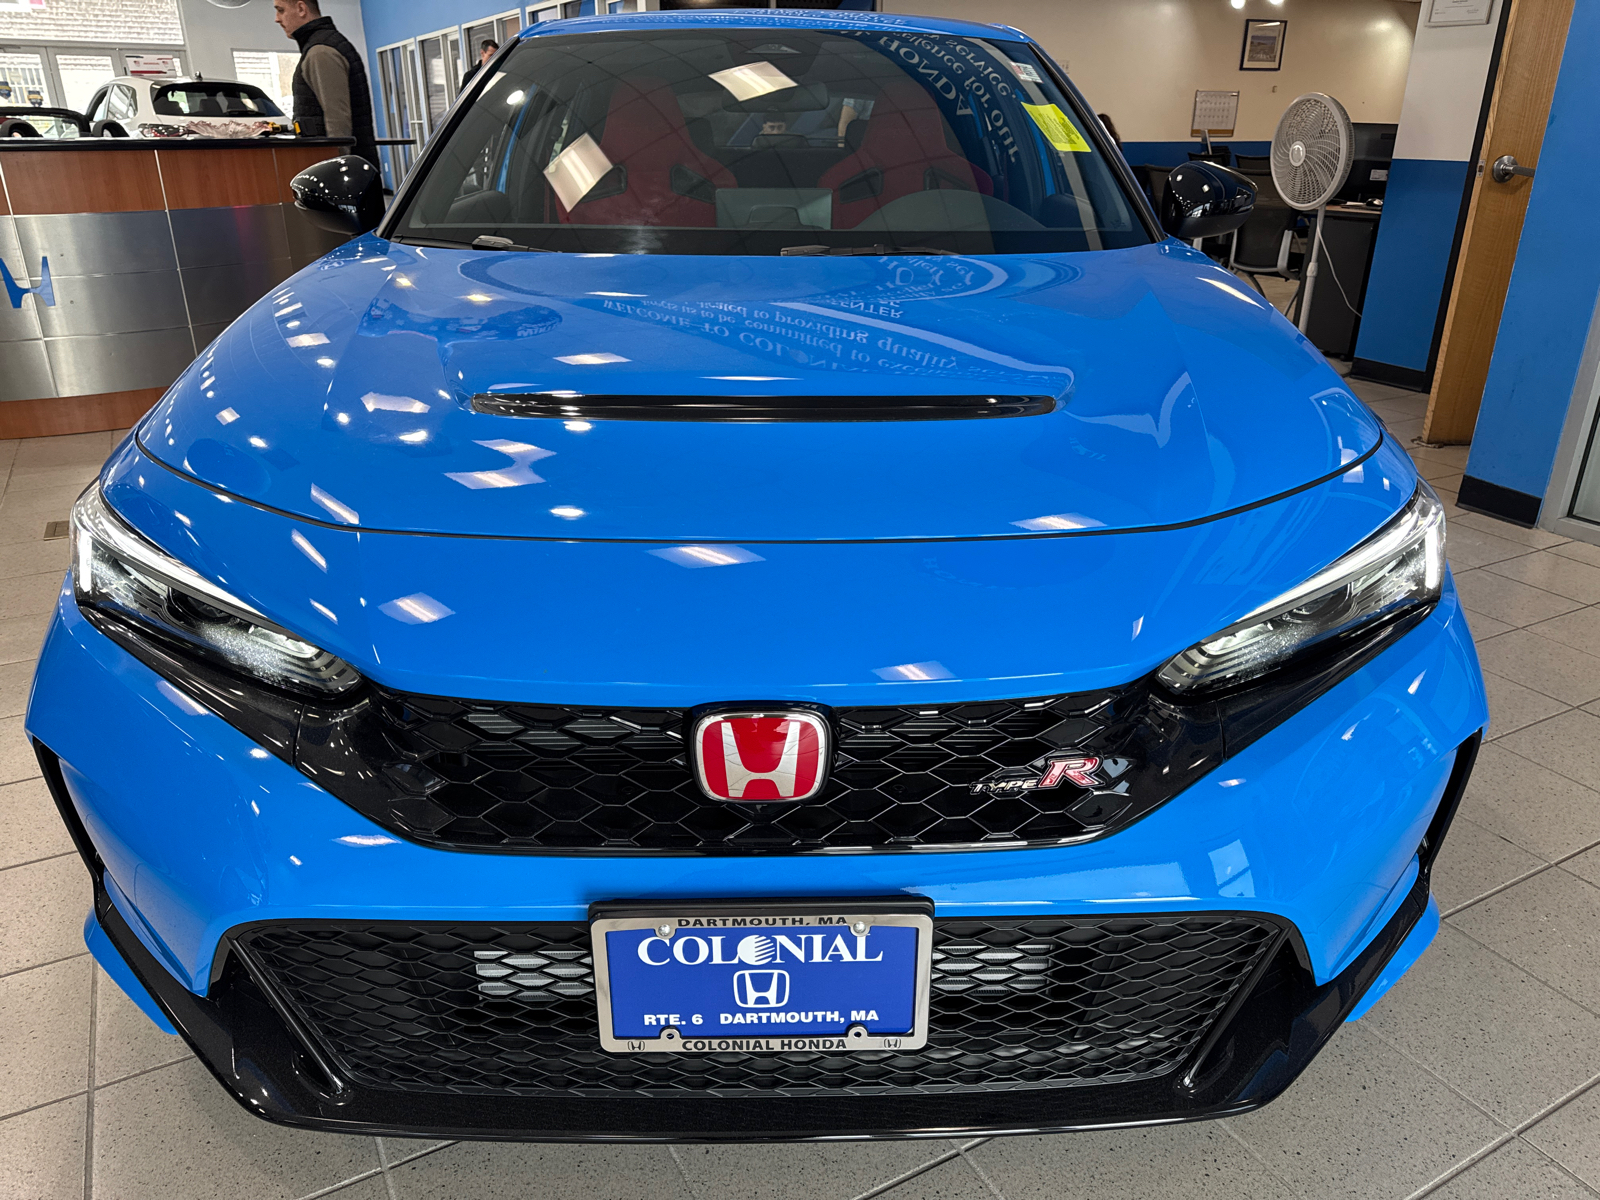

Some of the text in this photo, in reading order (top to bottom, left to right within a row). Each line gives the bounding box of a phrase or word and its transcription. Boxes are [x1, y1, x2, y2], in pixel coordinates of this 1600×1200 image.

[970, 756, 1101, 796] TYPE R
[677, 916, 848, 928] DARTMOUTH, MA
[637, 933, 884, 967] COLONIAL
[643, 1009, 880, 1026] RTE. 6 DARTMOUTH, MA
[681, 1038, 848, 1052] COLONIAL HONDA
